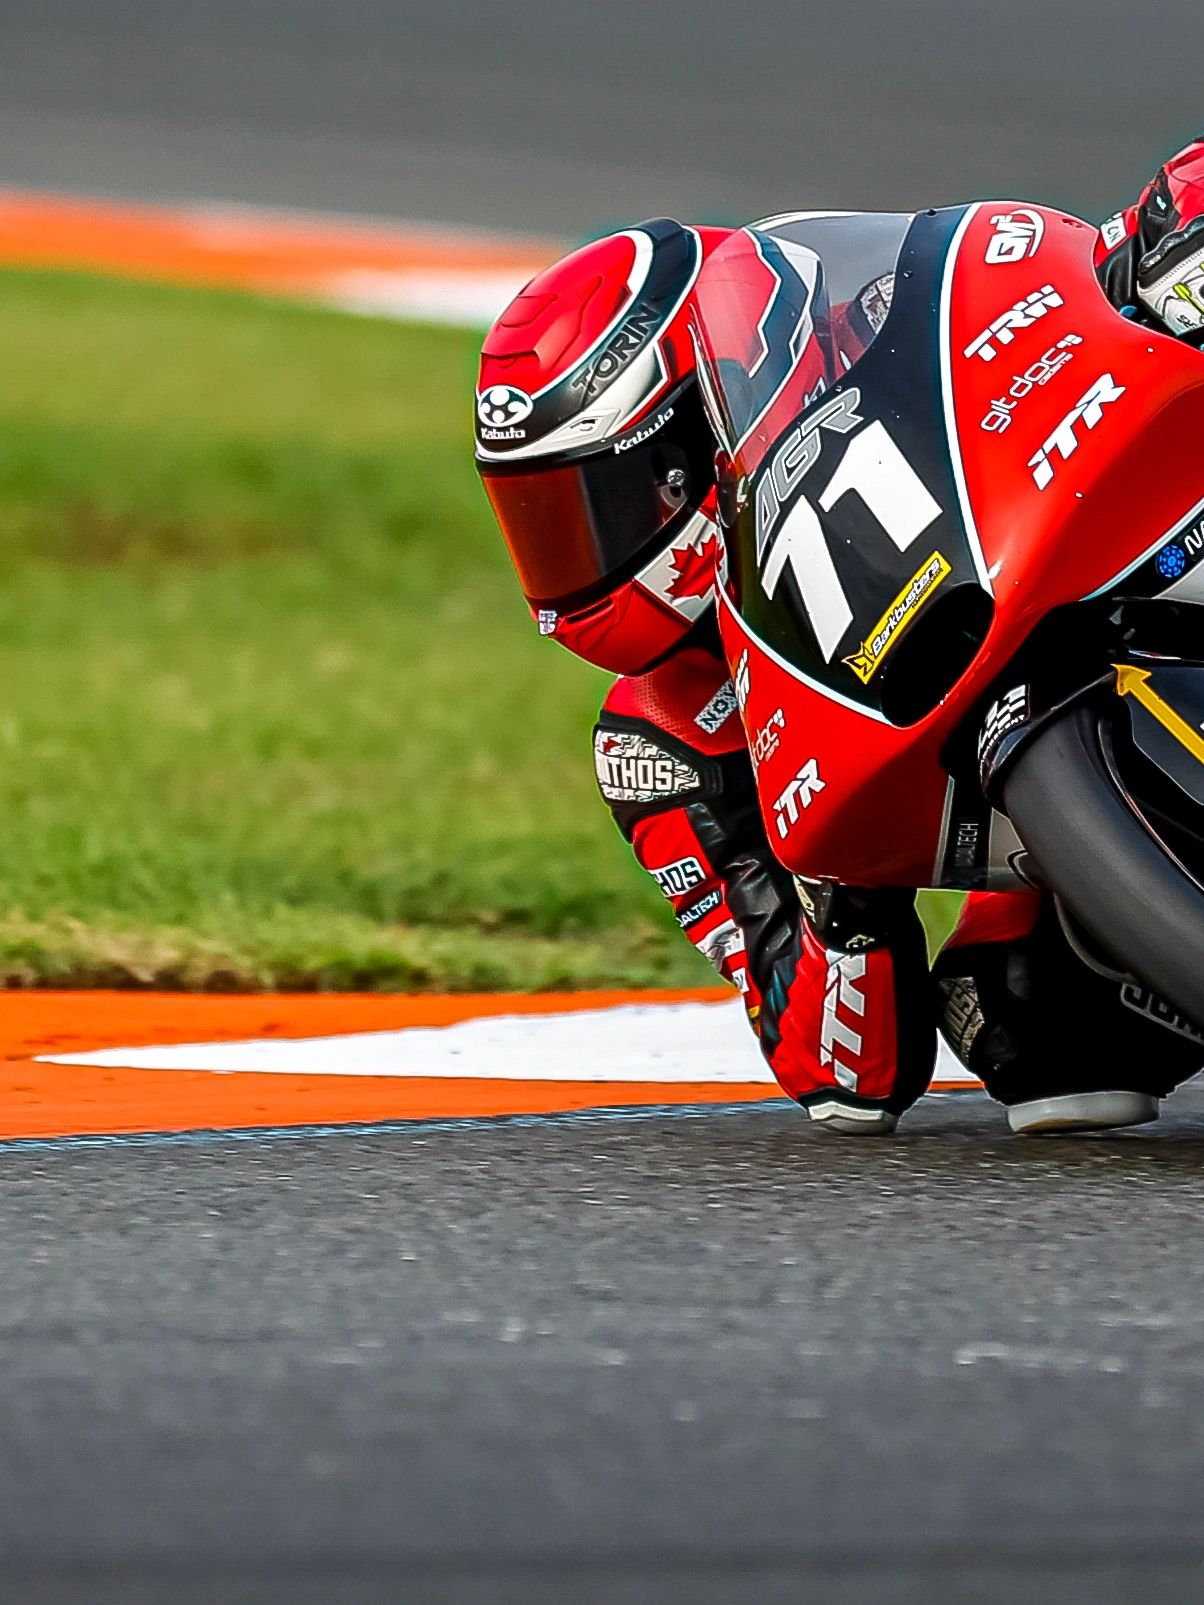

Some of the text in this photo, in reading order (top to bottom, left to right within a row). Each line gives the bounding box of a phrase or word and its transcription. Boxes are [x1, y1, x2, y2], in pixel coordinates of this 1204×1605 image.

[571, 303, 661, 394] TORIN
[481, 427, 527, 440] Kabuto
[614, 407, 675, 455] Kabuto
[761, 419, 944, 664] 71
[872, 558, 941, 657] Barkbusters
